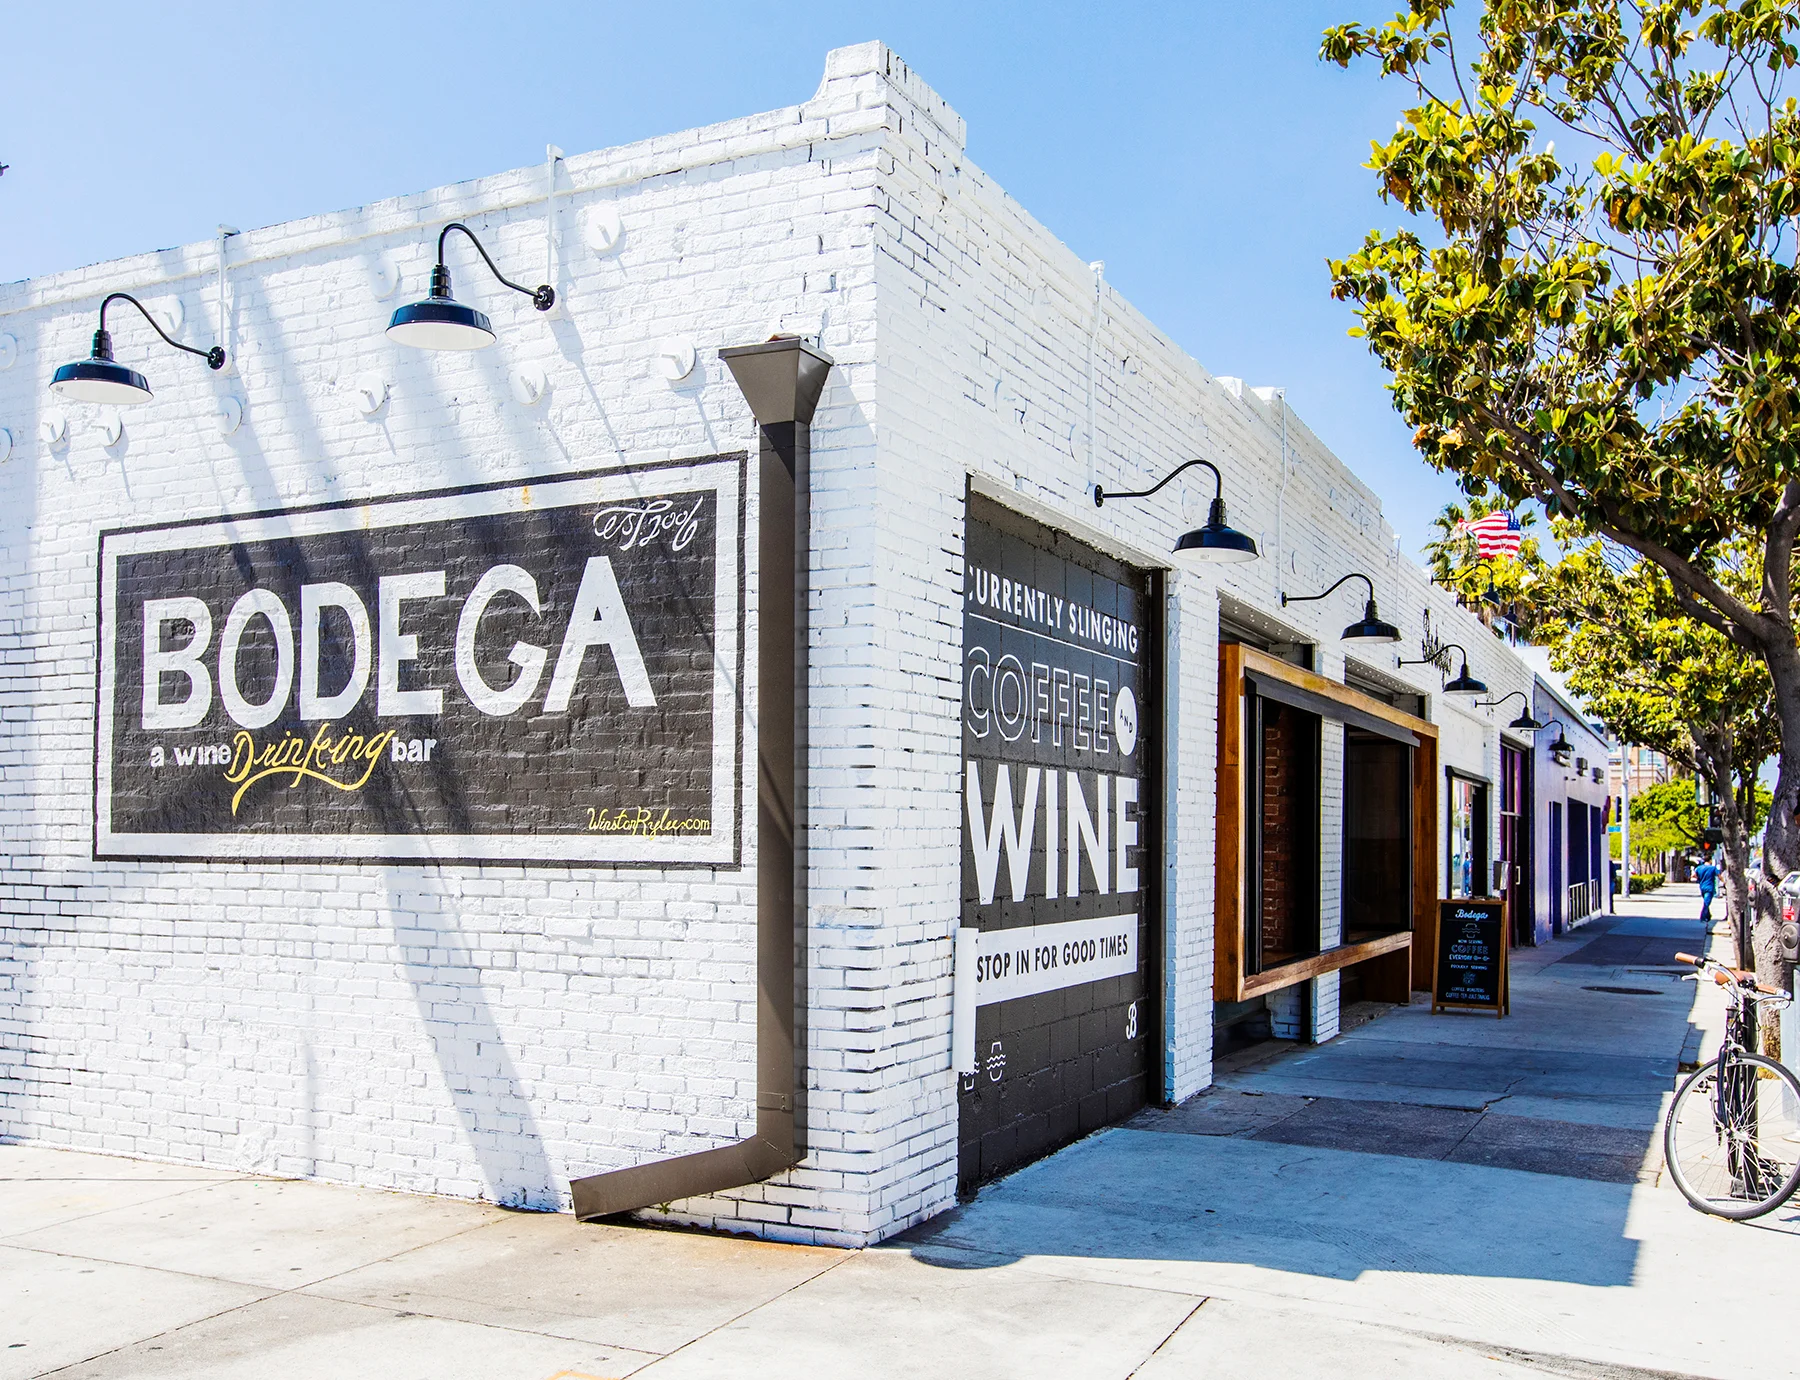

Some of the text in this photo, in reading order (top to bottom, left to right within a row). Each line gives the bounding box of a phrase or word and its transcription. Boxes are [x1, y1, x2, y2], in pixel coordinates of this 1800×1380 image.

[141, 555, 658, 730] BODEGA
[968, 564, 1138, 654] URRENTLY SLINGING
[967, 646, 1109, 754] COFFEE
[1120, 709, 1134, 733] AND
[151, 723, 437, 816] a wine Drinking bar
[966, 760, 1139, 905] WINE
[976, 933, 1128, 983] STOP IN FOR GOOD TIMES
[1451, 944, 1488, 954] COFFEE
[1455, 909, 1489, 921] Bodega
